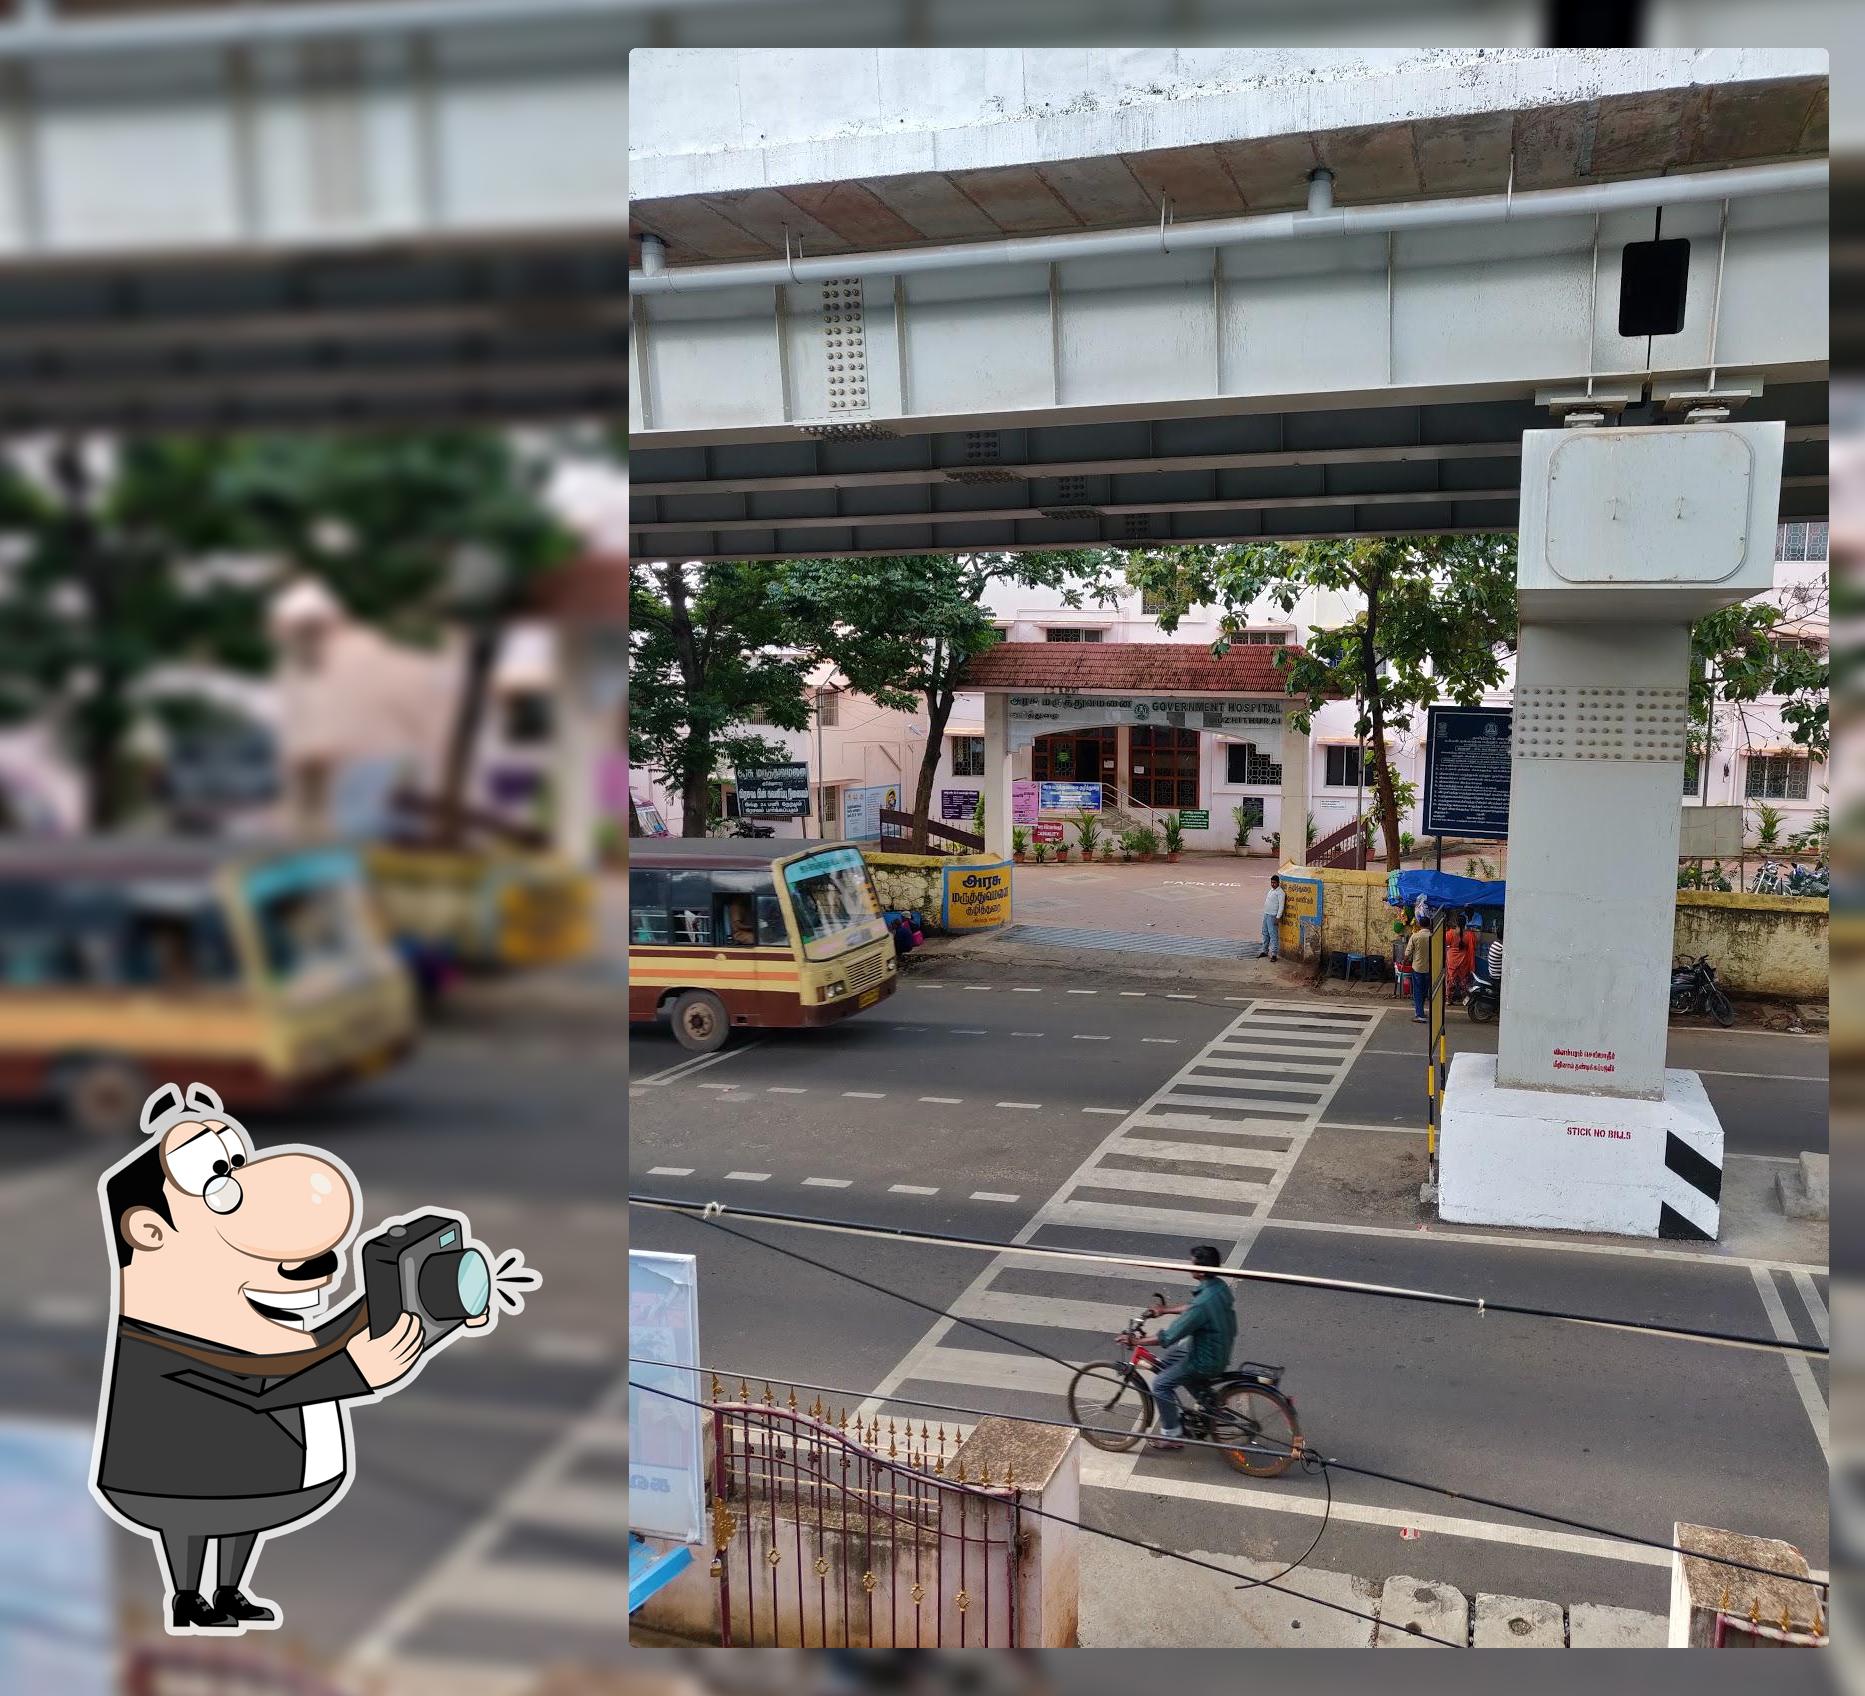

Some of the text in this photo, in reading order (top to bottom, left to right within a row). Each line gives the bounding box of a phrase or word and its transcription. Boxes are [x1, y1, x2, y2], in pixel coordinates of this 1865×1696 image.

[1152, 702, 1282, 713] GOVERNMENT HOSPITAL
[962, 875, 1001, 890] அரசு
[1567, 1127, 1632, 1140] STICK NO BILLS
